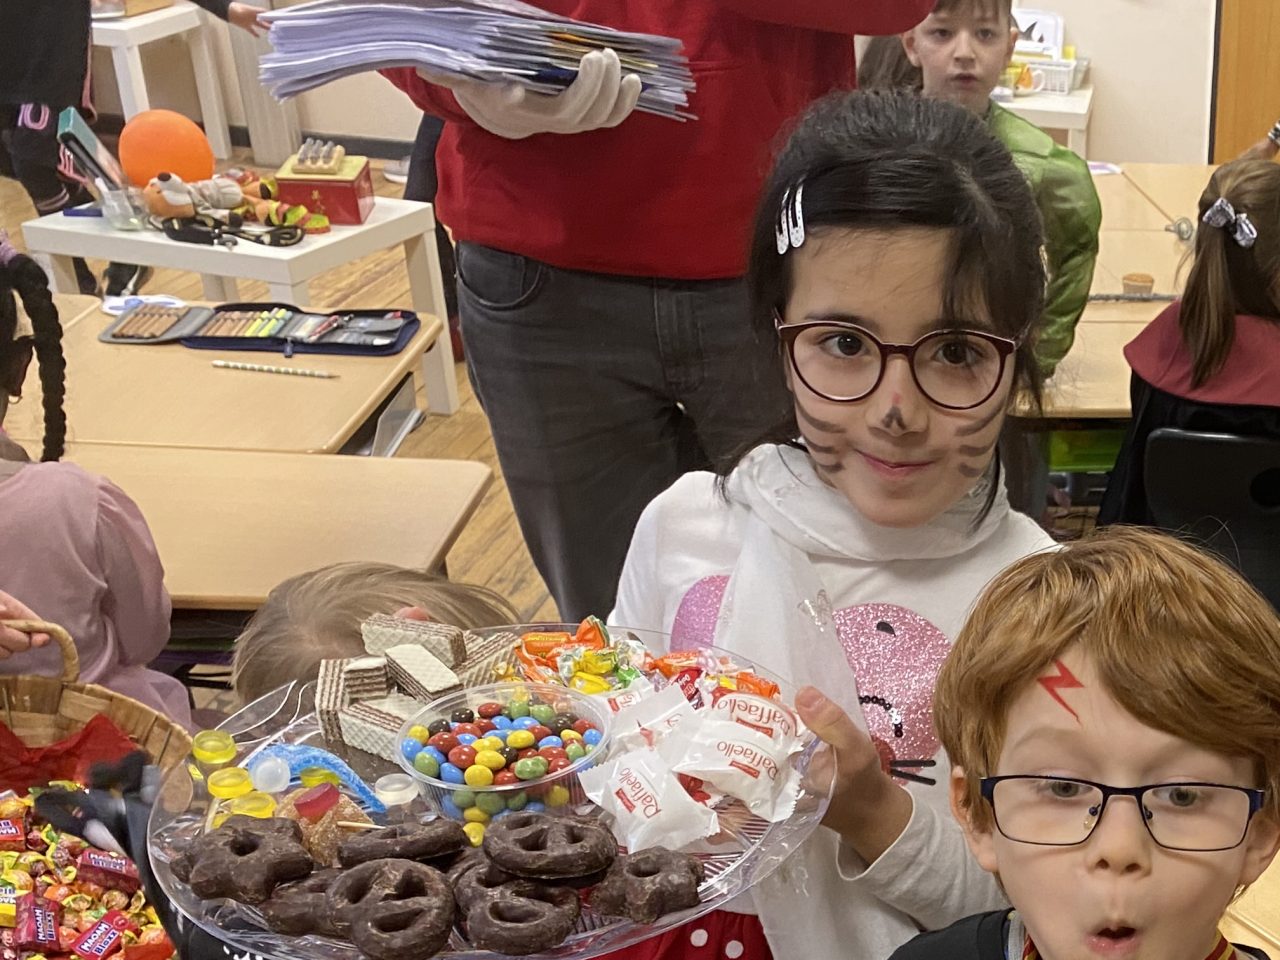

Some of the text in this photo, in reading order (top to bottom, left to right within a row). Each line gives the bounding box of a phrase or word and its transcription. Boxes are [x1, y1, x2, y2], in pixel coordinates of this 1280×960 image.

[716, 740, 777, 781] Raffaello
[619, 767, 662, 819] Raffaello
[34, 909, 47, 941] MAOAM
[79, 922, 110, 952] MAOAM
[94, 931, 117, 954] Bloxx
